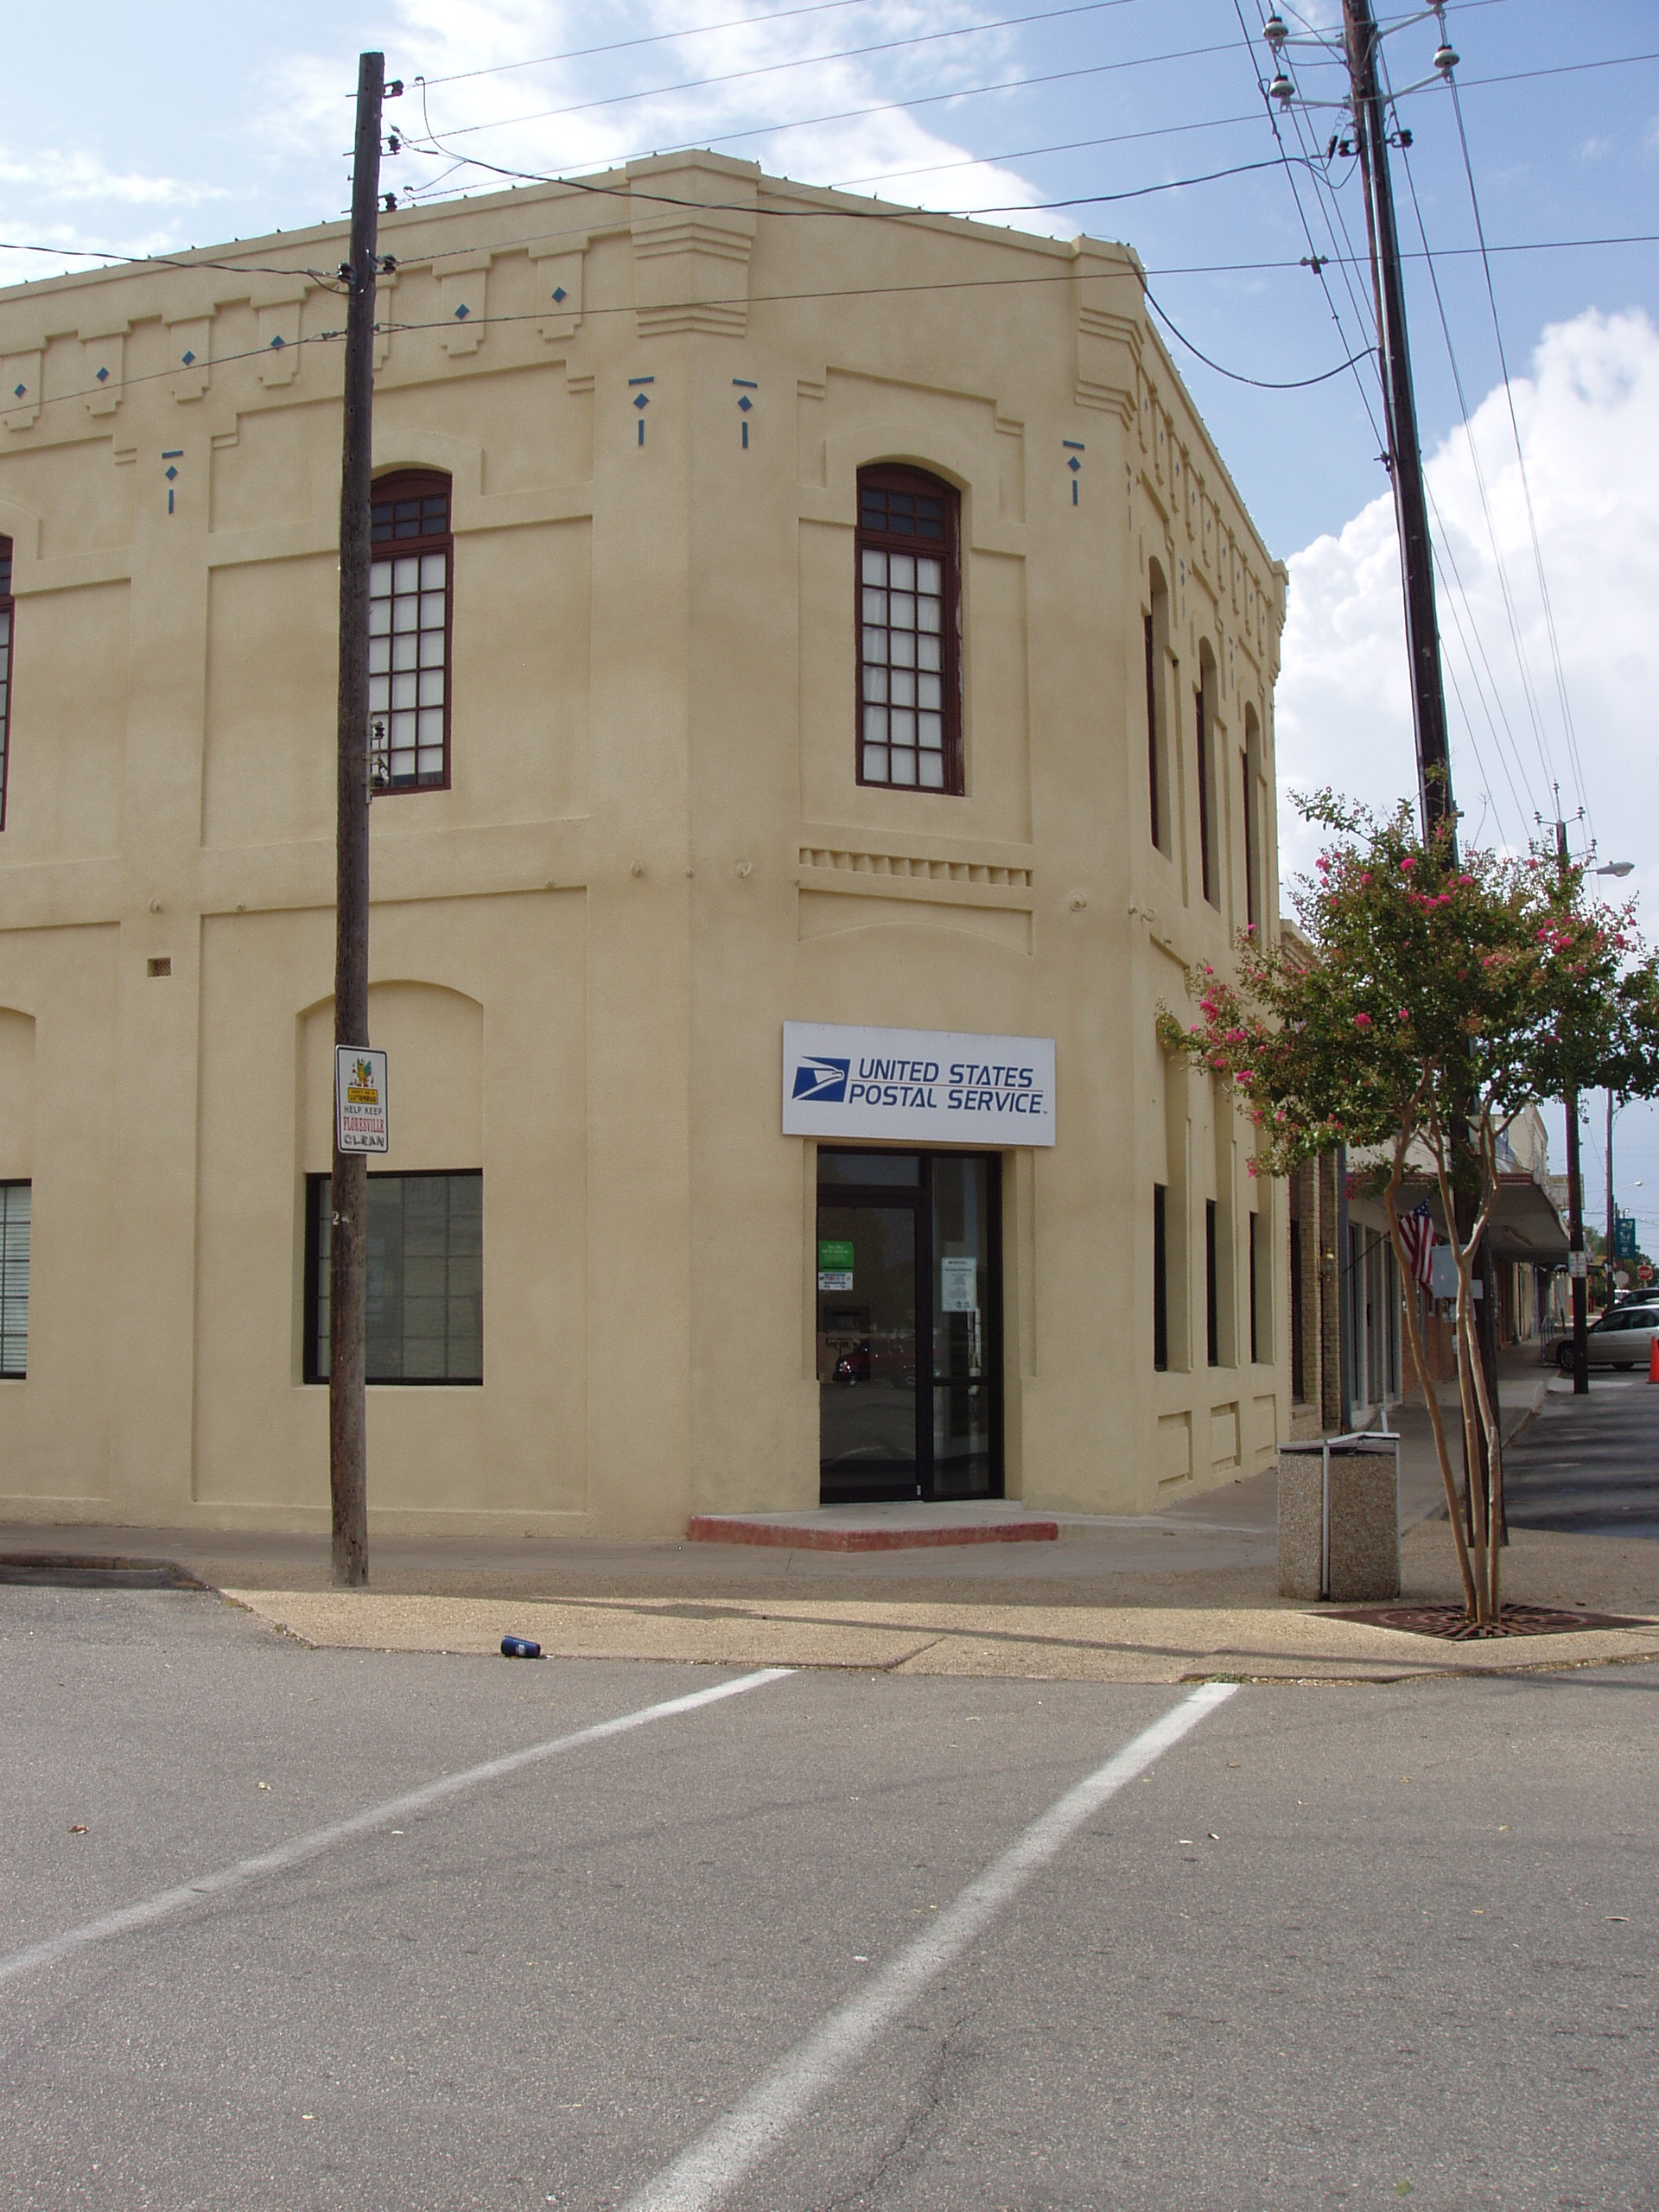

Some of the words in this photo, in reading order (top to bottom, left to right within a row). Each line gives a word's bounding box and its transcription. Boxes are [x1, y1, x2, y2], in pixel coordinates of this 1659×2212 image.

[859, 1058, 939, 1083] UNITED
[949, 1064, 1033, 1088] STATES
[849, 1083, 938, 1109] POSTAL
[947, 1090, 1044, 1114] SERVICE
[344, 1105, 362, 1115] HELP
[365, 1107, 383, 1116] KEEP
[343, 1116, 384, 1133] FLORESVILLE
[345, 1134, 384, 1147] CLEAN
